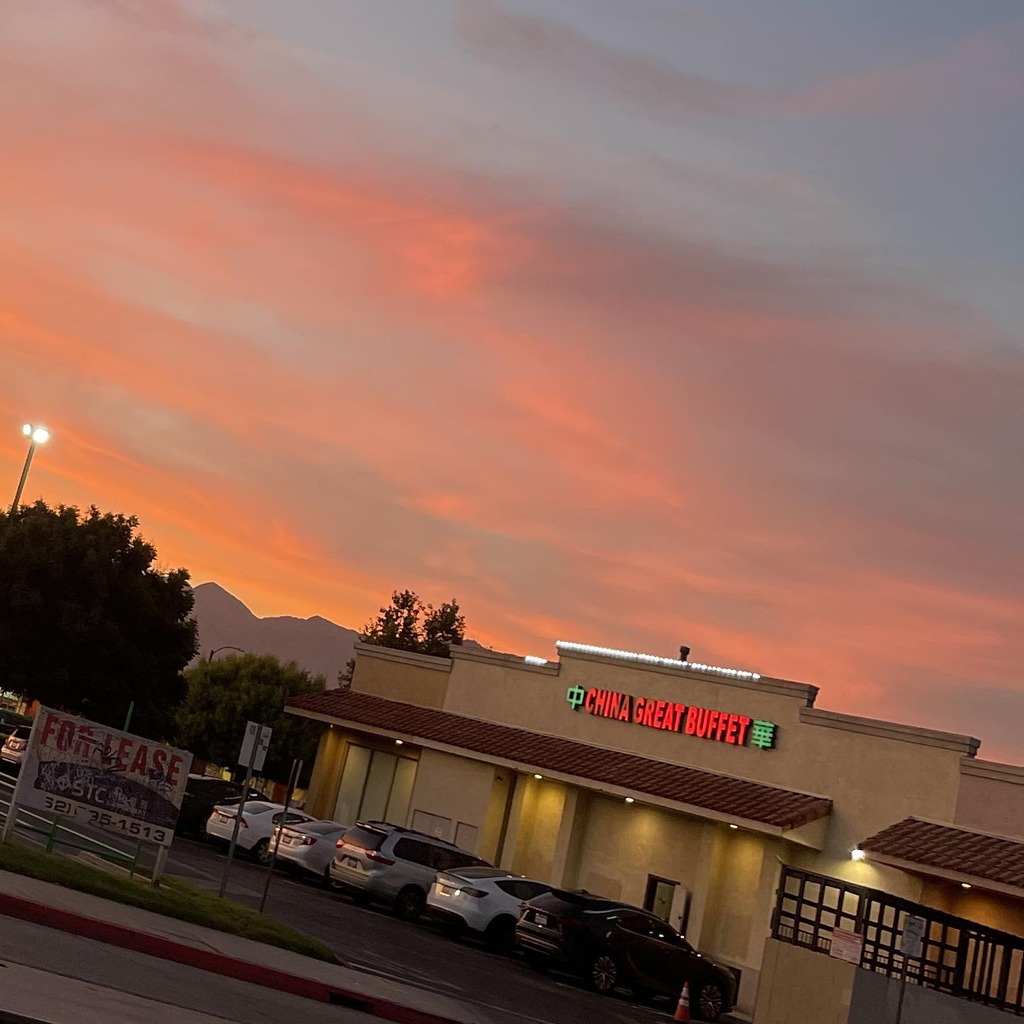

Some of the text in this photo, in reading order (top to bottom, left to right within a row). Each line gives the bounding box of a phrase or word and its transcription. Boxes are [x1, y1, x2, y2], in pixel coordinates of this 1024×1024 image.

[566, 685, 585, 710] 中
[584, 687, 750, 746] CHINA GREAT BUFFET
[39, 714, 94, 759] FOR
[100, 733, 184, 787] LEASE
